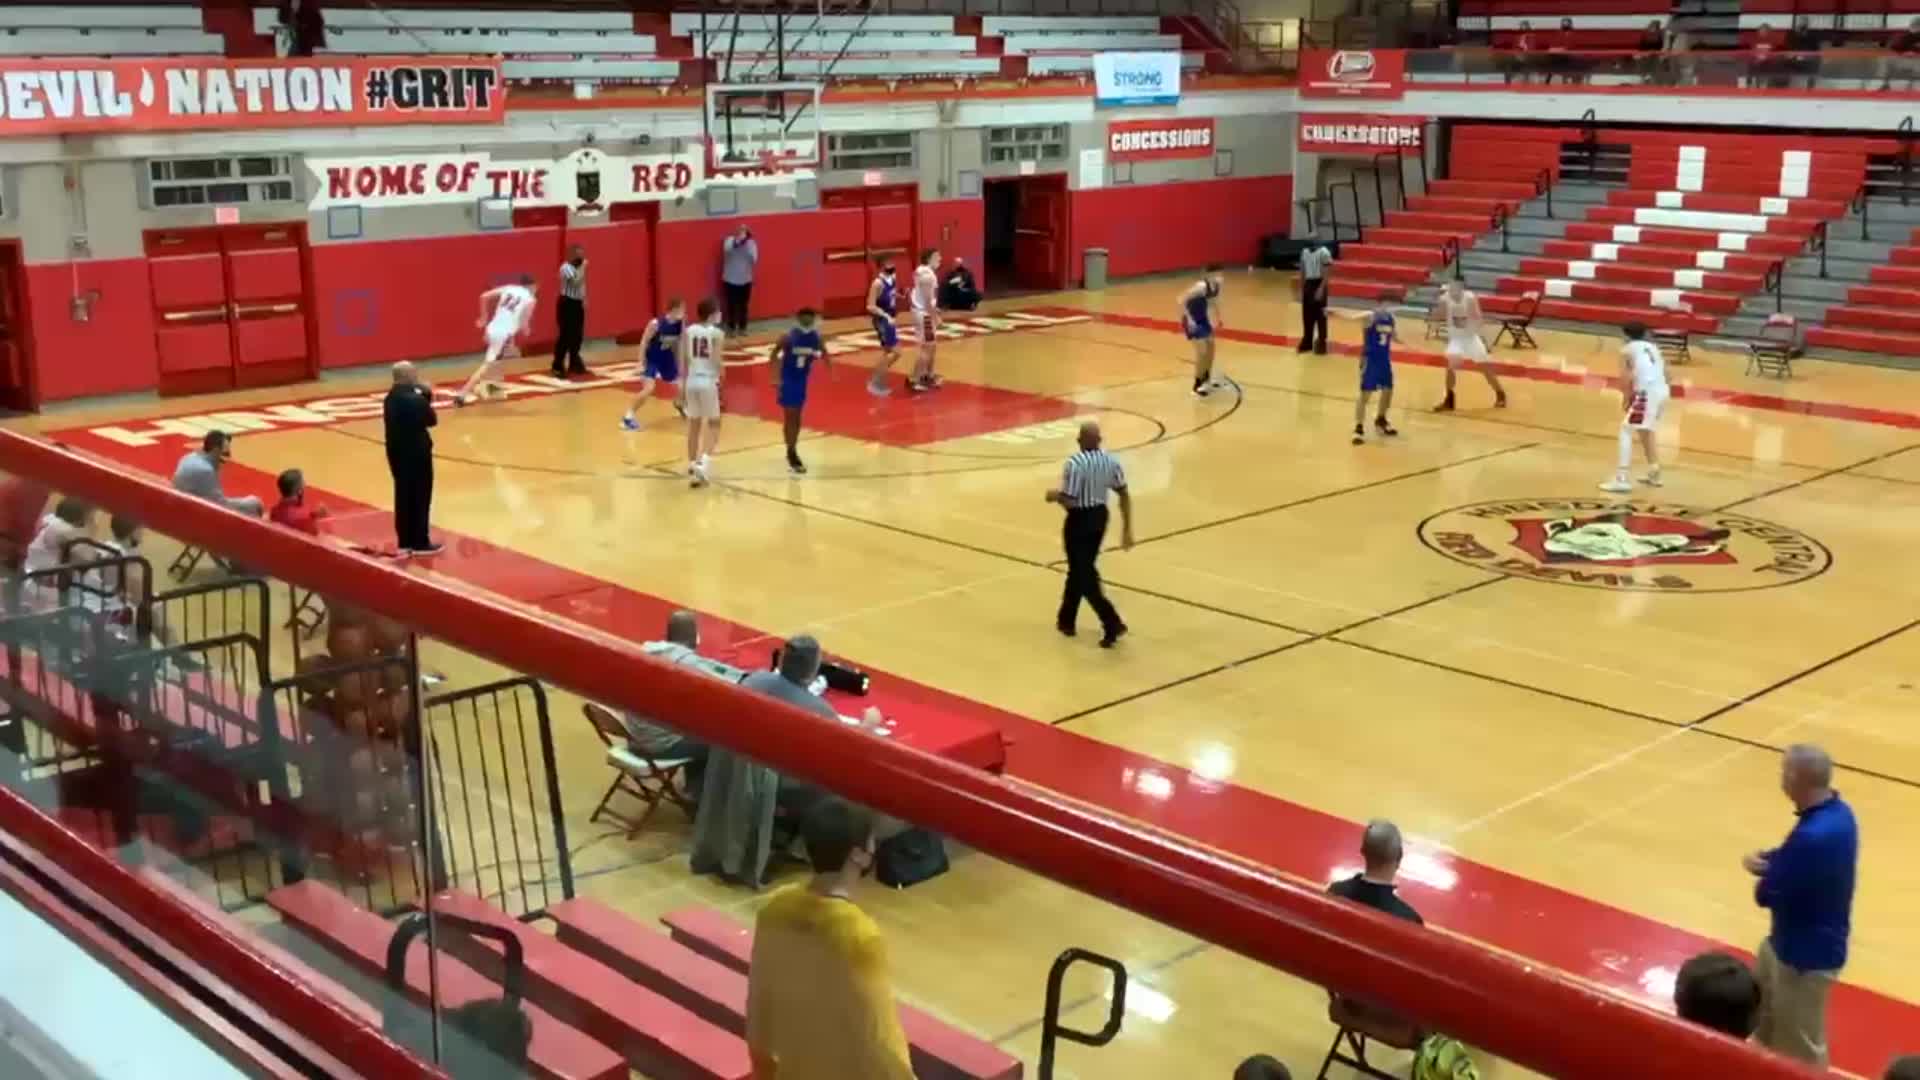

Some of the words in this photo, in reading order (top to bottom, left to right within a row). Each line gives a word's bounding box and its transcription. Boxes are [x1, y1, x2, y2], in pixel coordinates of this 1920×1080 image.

[1112, 71, 1163, 87] STRONG
[0, 69, 133, 119] EVIL
[165, 66, 352, 115] NATION
[364, 66, 496, 112] #GRIT
[1110, 127, 1211, 152] CONCESSIONS
[326, 163, 428, 199] HOME
[435, 161, 480, 193] OF
[486, 169, 549, 199] THE
[631, 162, 693, 193] RED
[692, 335, 710, 358] 12
